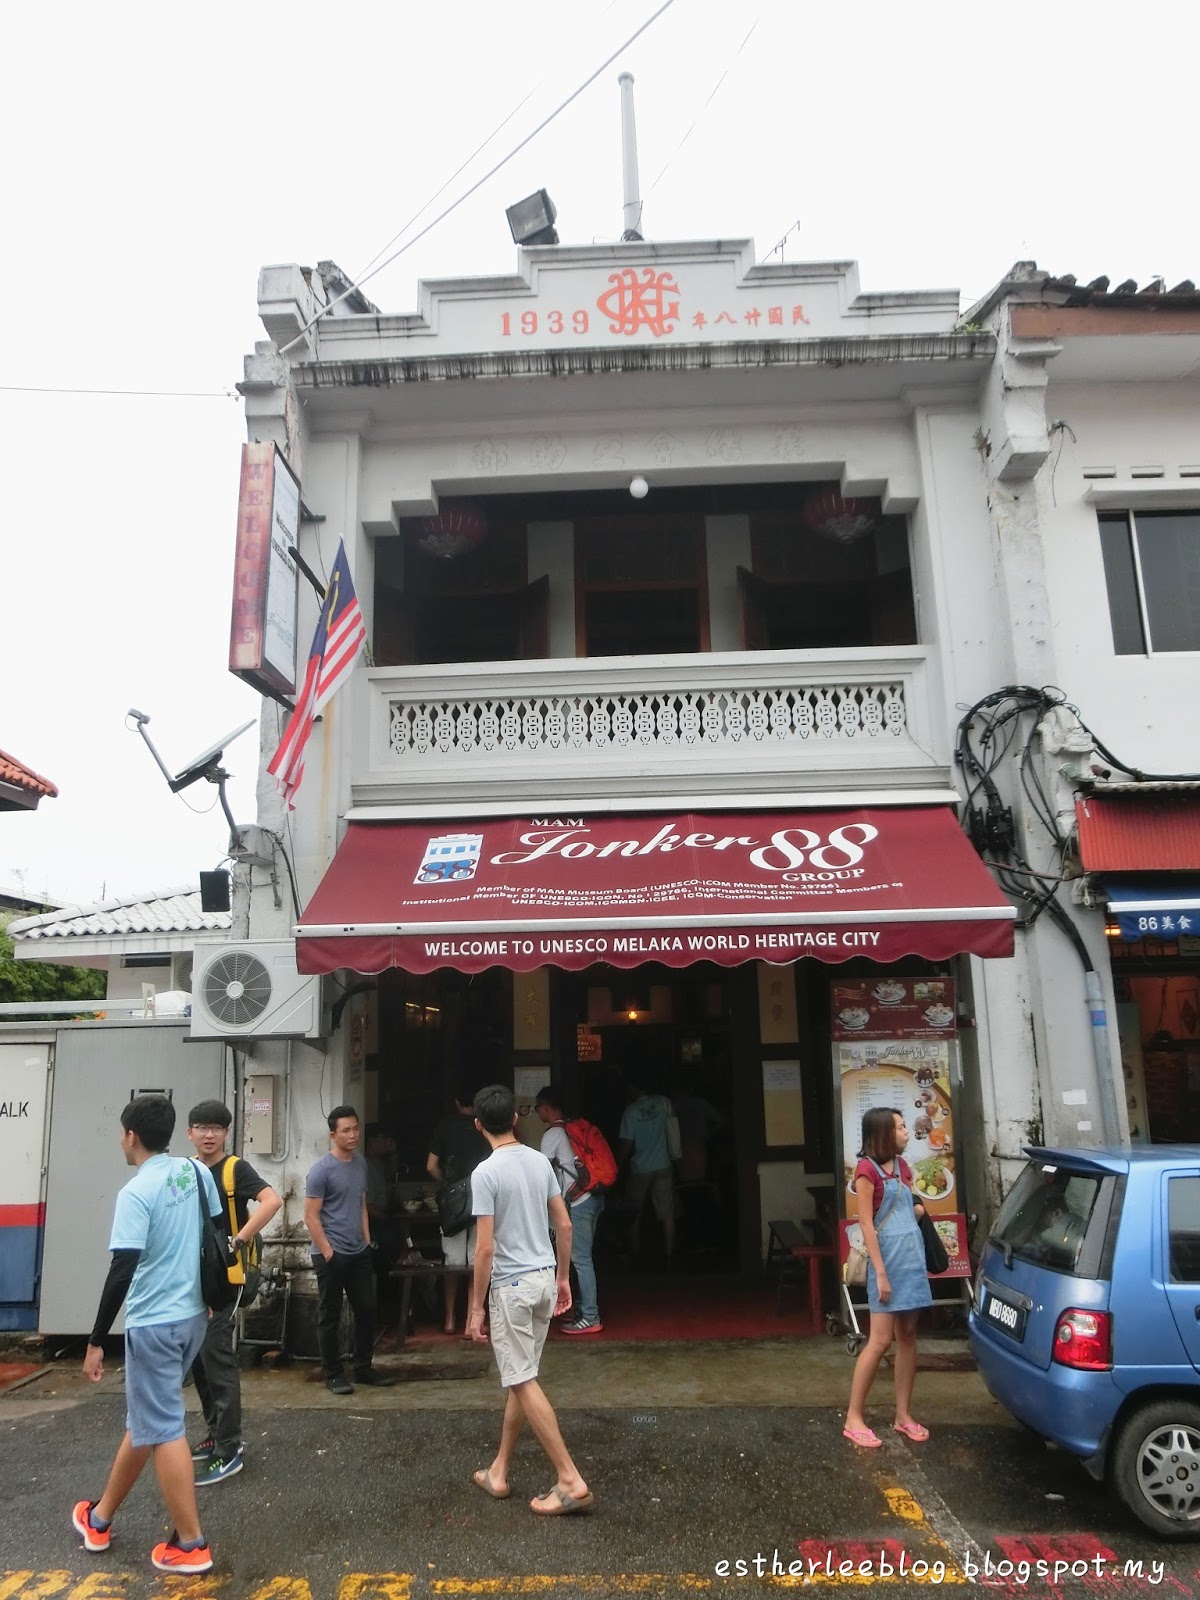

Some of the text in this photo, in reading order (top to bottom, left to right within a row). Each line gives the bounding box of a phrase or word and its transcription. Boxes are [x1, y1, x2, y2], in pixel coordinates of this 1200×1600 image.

[500, 310, 589, 336] 1939
[530, 818, 586, 827] MAM
[490, 823, 879, 870] Jonker 88
[782, 868, 866, 882] GROUP
[402, 895, 471, 906] Institutional
[473, 891, 519, 900] Member
[694, 886, 768, 895] International
[836, 883, 890, 894] Members
[476, 884, 521, 893] Member
[537, 887, 565, 895] MAM
[616, 886, 647, 894] Board
[733, 881, 779, 889] Member
[425, 931, 881, 957] WELCOME TO UNESCO MELAKA WORLD HERITAGE CITY
